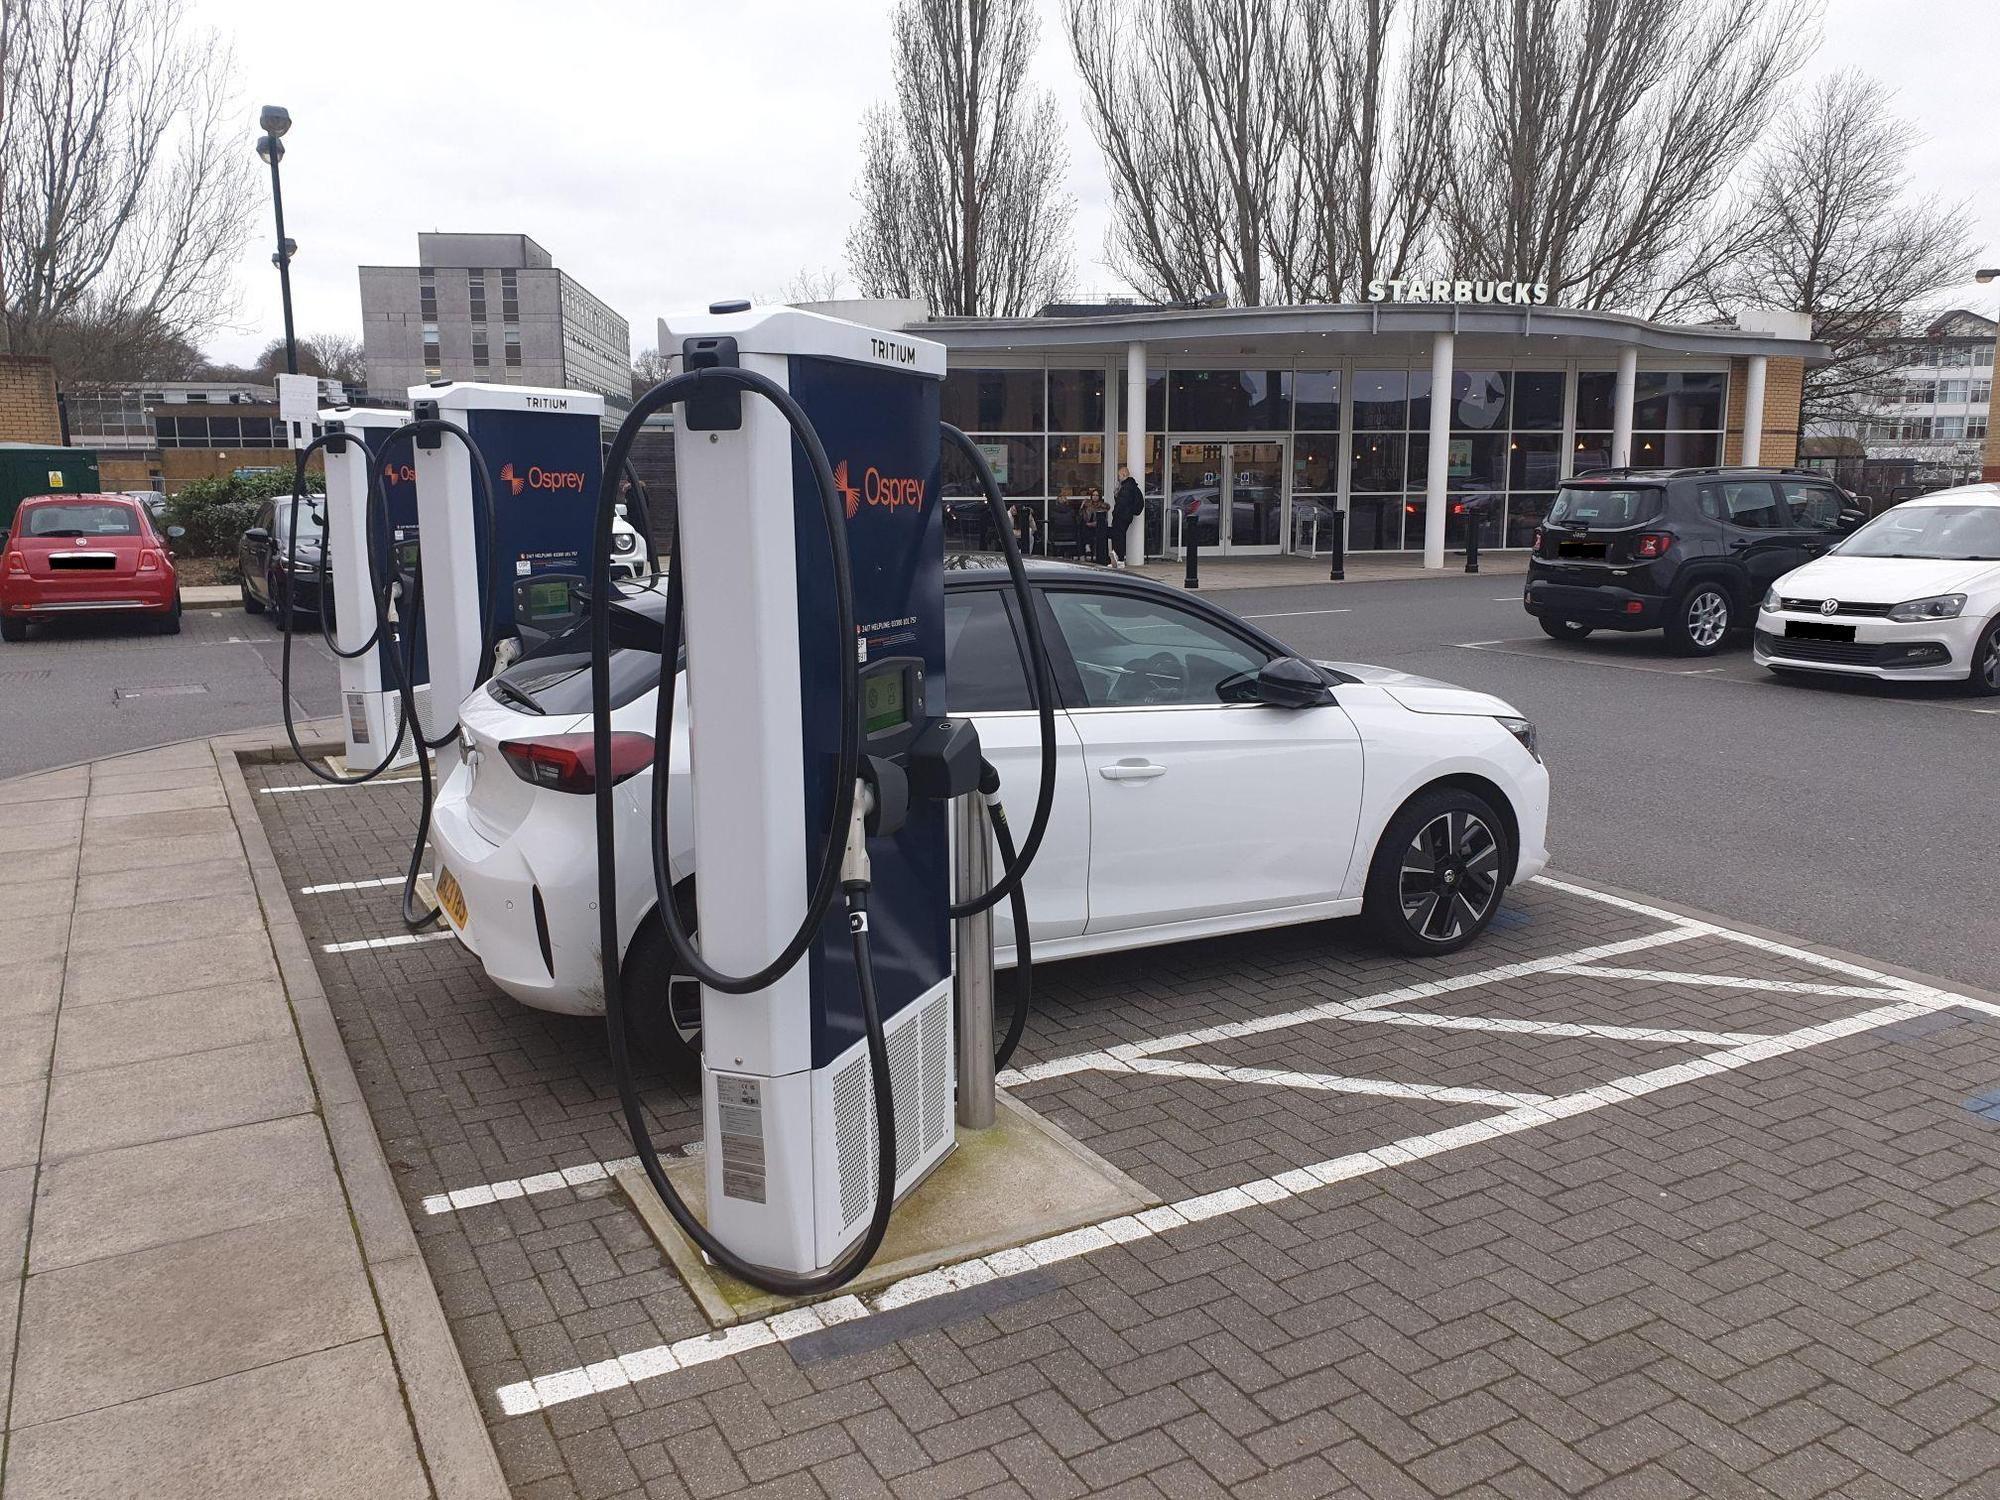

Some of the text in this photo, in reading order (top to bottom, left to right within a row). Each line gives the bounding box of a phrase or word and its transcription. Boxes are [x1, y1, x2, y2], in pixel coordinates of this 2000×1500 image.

[1367, 279, 1549, 304] STARBUCKS
[870, 338, 916, 365] TRITIUM
[526, 396, 568, 409] TRITIUM
[528, 466, 585, 493] Osprey
[864, 466, 926, 514] Osprey
